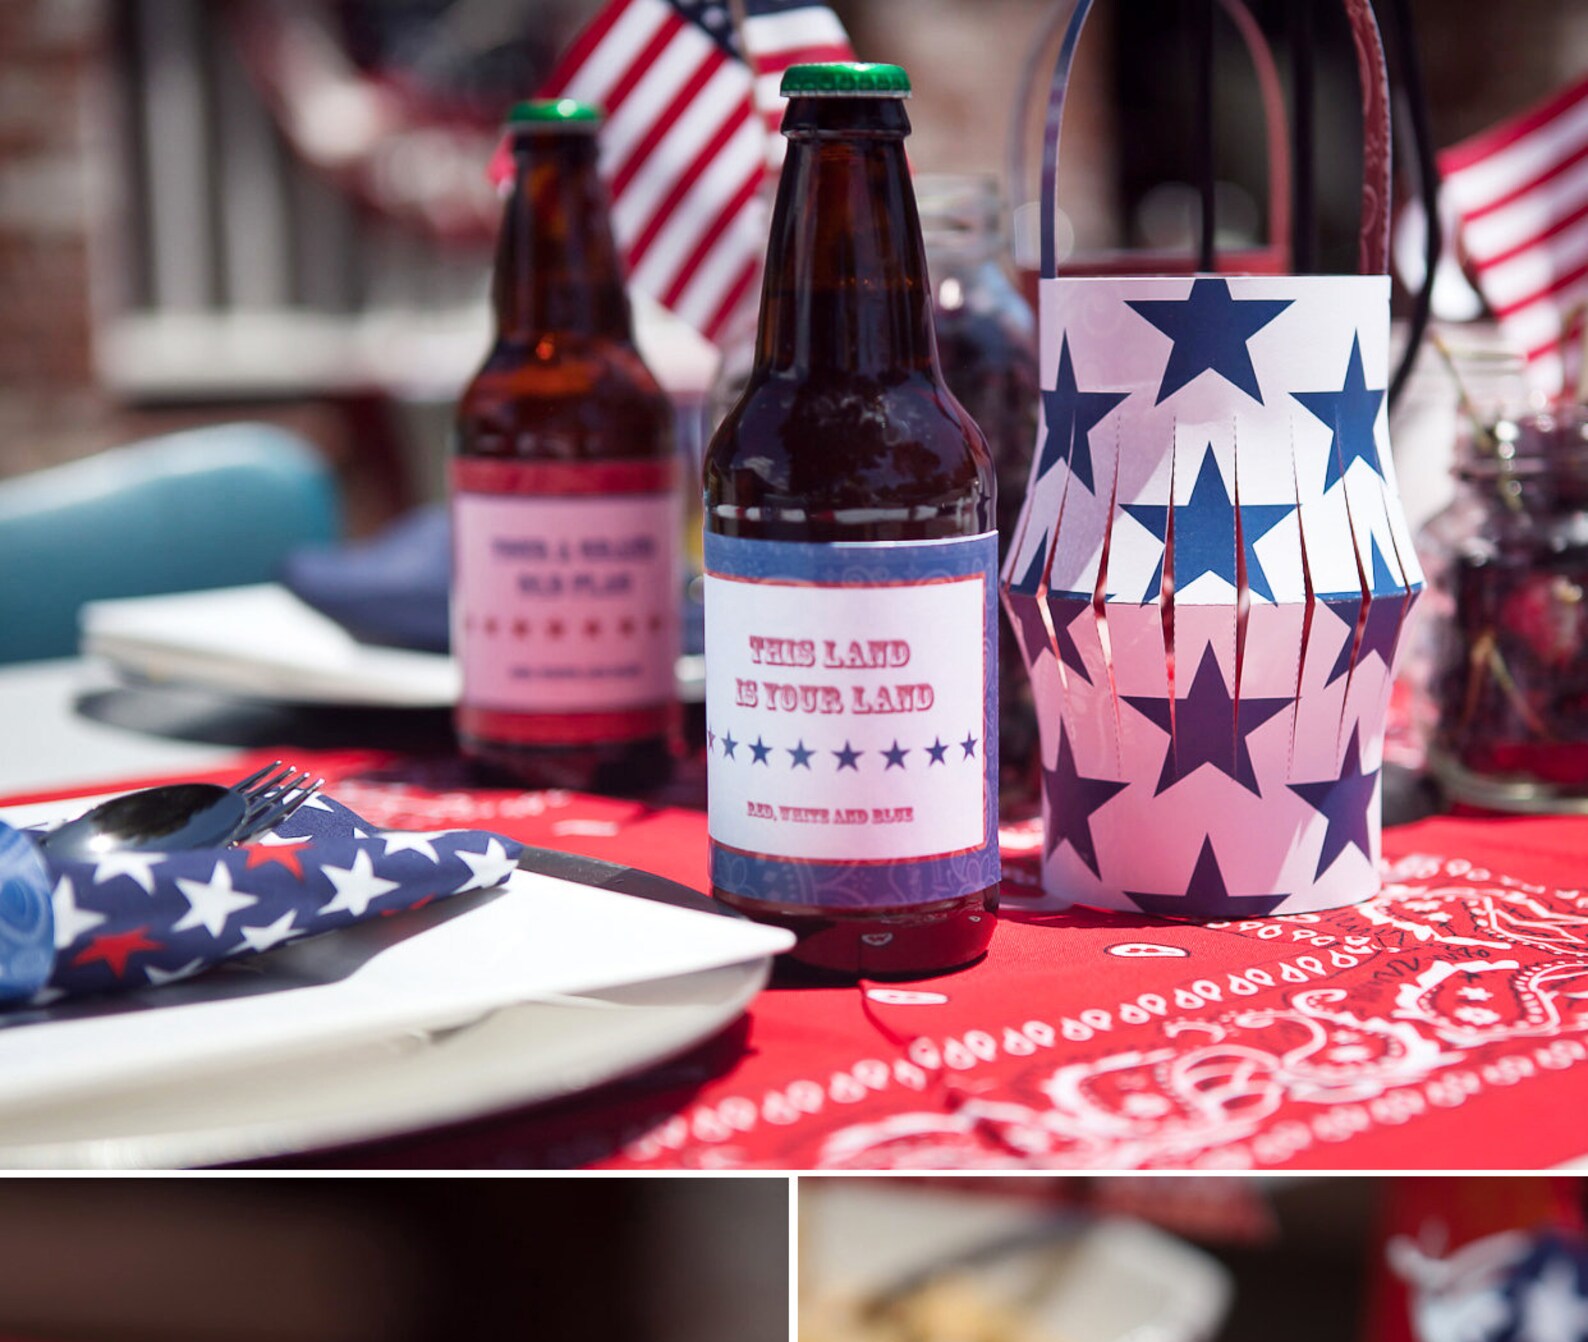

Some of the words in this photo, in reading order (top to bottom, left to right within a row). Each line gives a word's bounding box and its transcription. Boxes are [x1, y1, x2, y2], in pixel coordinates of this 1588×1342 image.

[749, 635, 816, 668] THIS
[823, 640, 911, 669] LAND
[735, 678, 758, 708] IS
[763, 682, 844, 715] YOUR
[851, 683, 935, 715] LAND
[779, 806, 829, 824] WHITE
[832, 808, 869, 825] AND
[871, 807, 914, 825] BLUE
